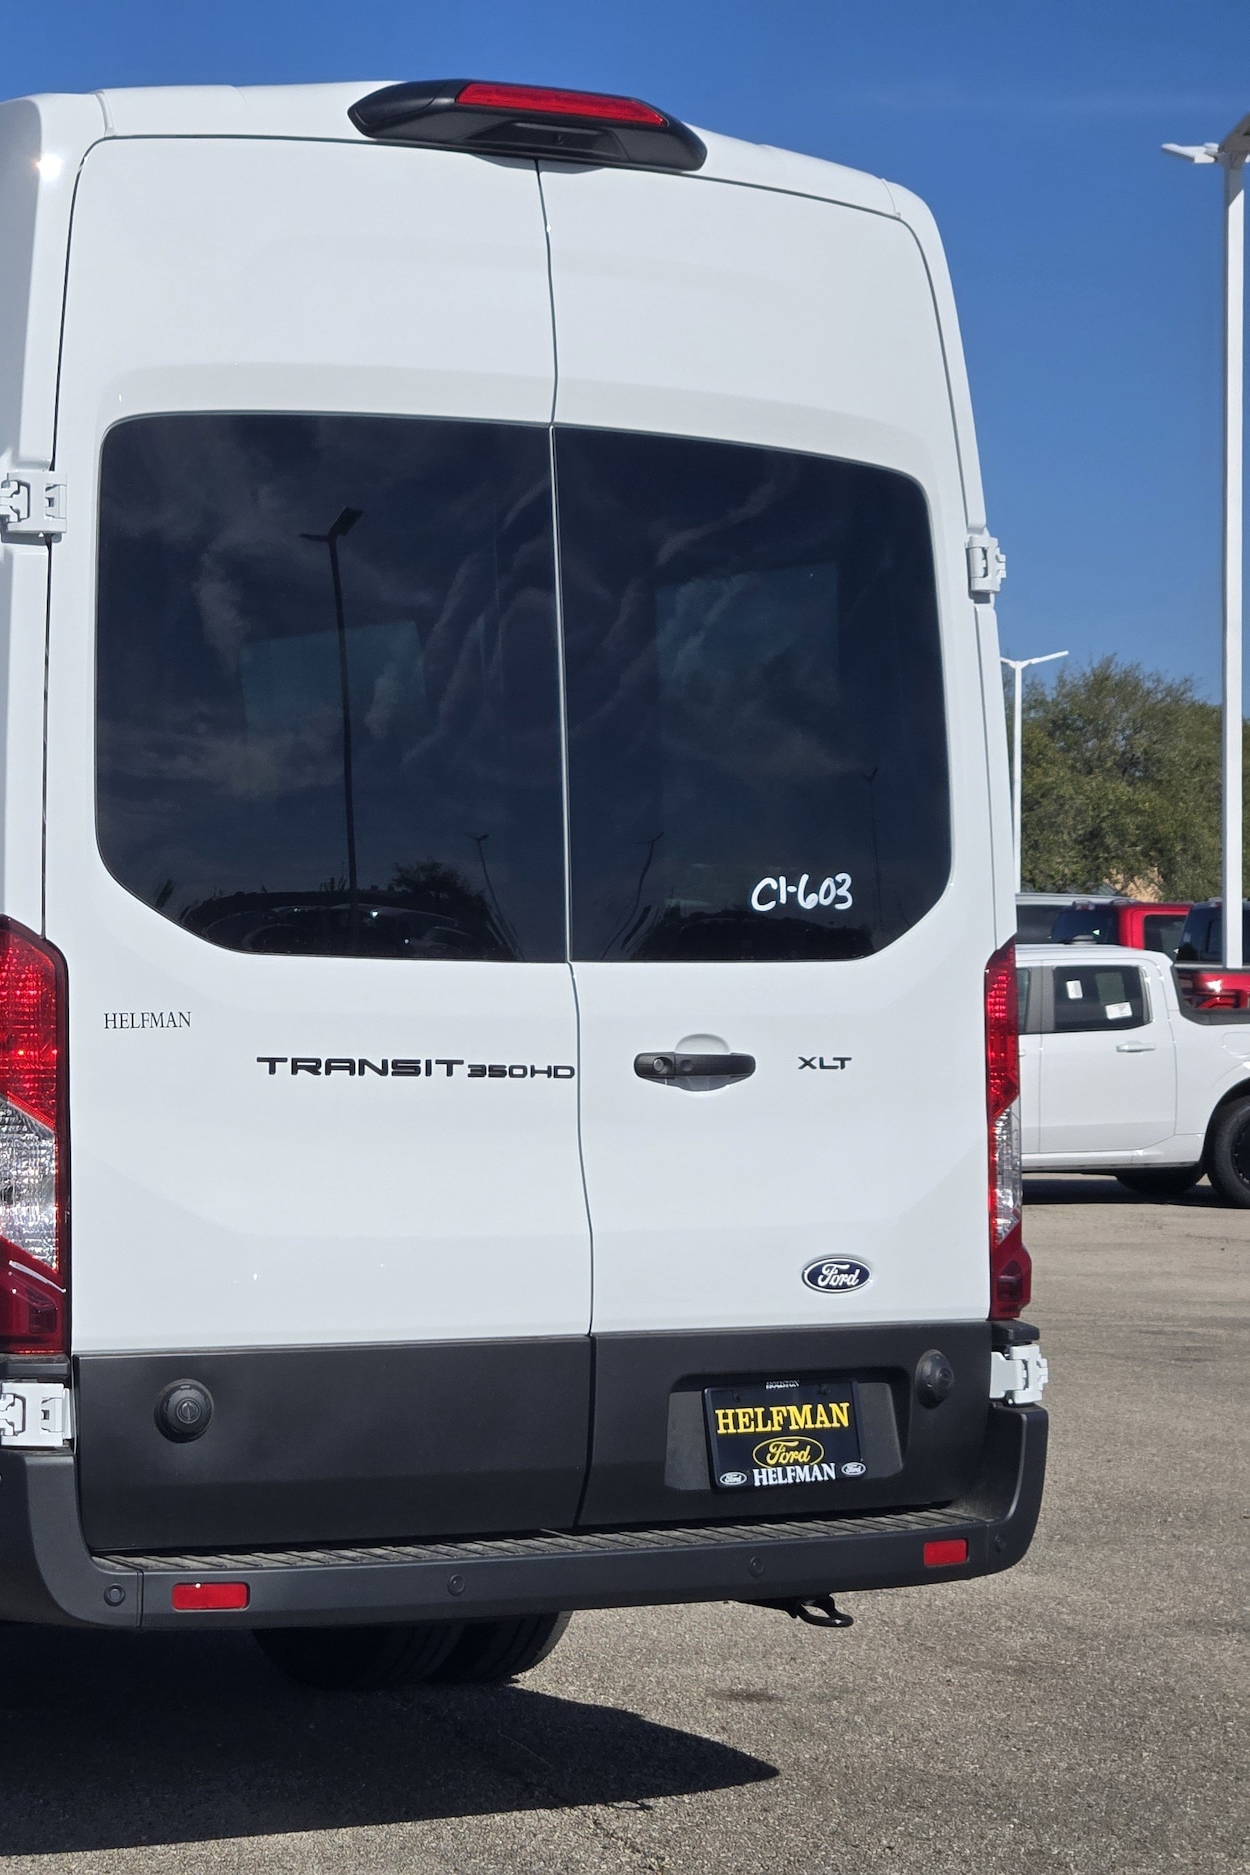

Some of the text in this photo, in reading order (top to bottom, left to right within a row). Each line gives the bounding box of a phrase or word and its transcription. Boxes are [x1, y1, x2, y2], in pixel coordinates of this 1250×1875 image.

[103, 1011, 191, 1030] HELFMAN
[256, 1056, 465, 1078] TRANSIT
[797, 1056, 853, 1070] XLT
[817, 1262, 861, 1287] Ford
[715, 1402, 851, 1434] HELFMAN
[765, 1440, 812, 1465] Ford
[752, 1463, 837, 1486] HELFMAN
